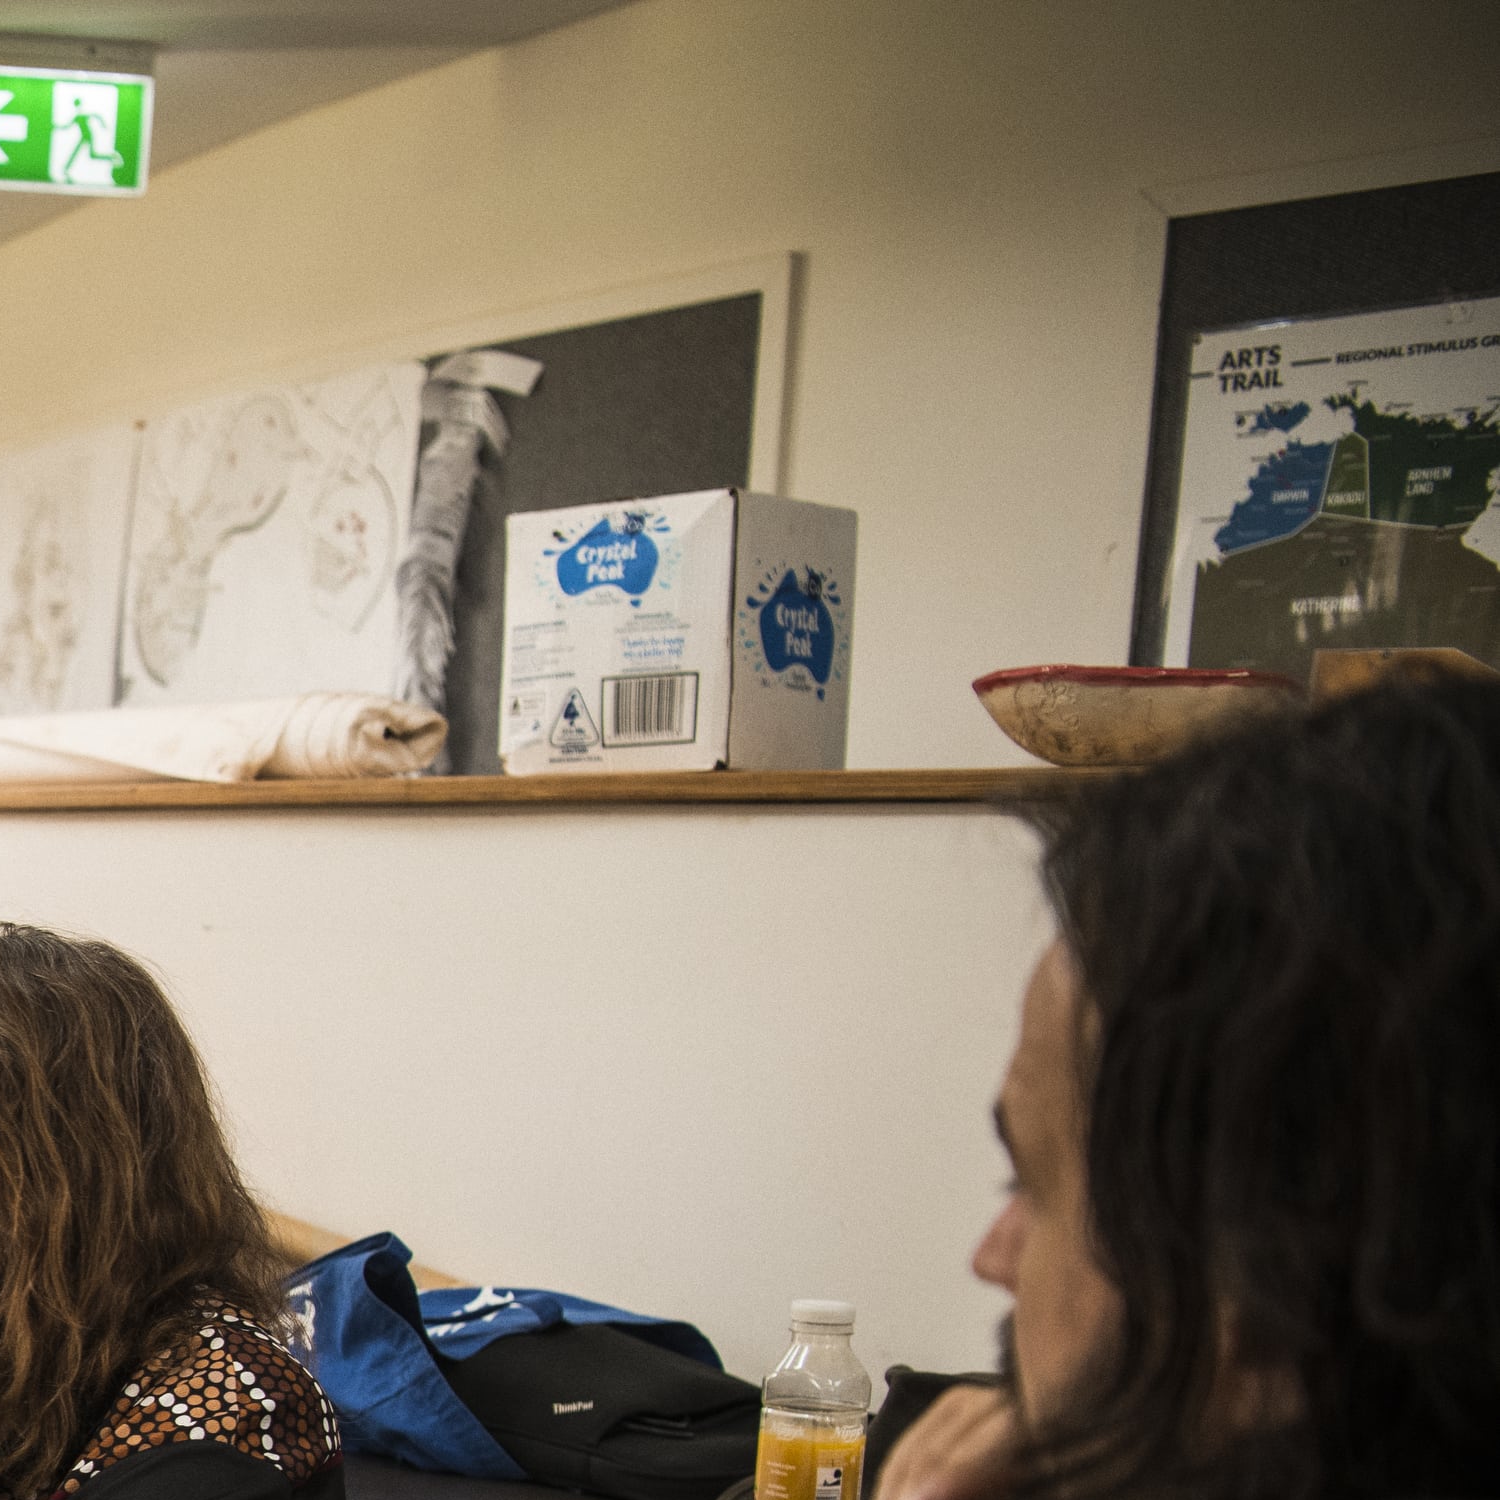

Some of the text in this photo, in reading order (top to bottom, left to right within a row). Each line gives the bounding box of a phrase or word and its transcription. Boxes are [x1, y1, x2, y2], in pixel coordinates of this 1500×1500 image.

[1220, 345, 1282, 371] ARTS
[1336, 348, 1405, 364] REGIONAL
[1407, 336, 1478, 355] STIMULUS
[1219, 369, 1283, 394] TRAIL
[1406, 482, 1435, 497] LAND
[576, 539, 638, 565] Crystal
[586, 560, 625, 583] Peak
[776, 603, 820, 633] Crystal
[784, 631, 813, 657] Peak
[552, 1400, 594, 1415] ThinkPad
